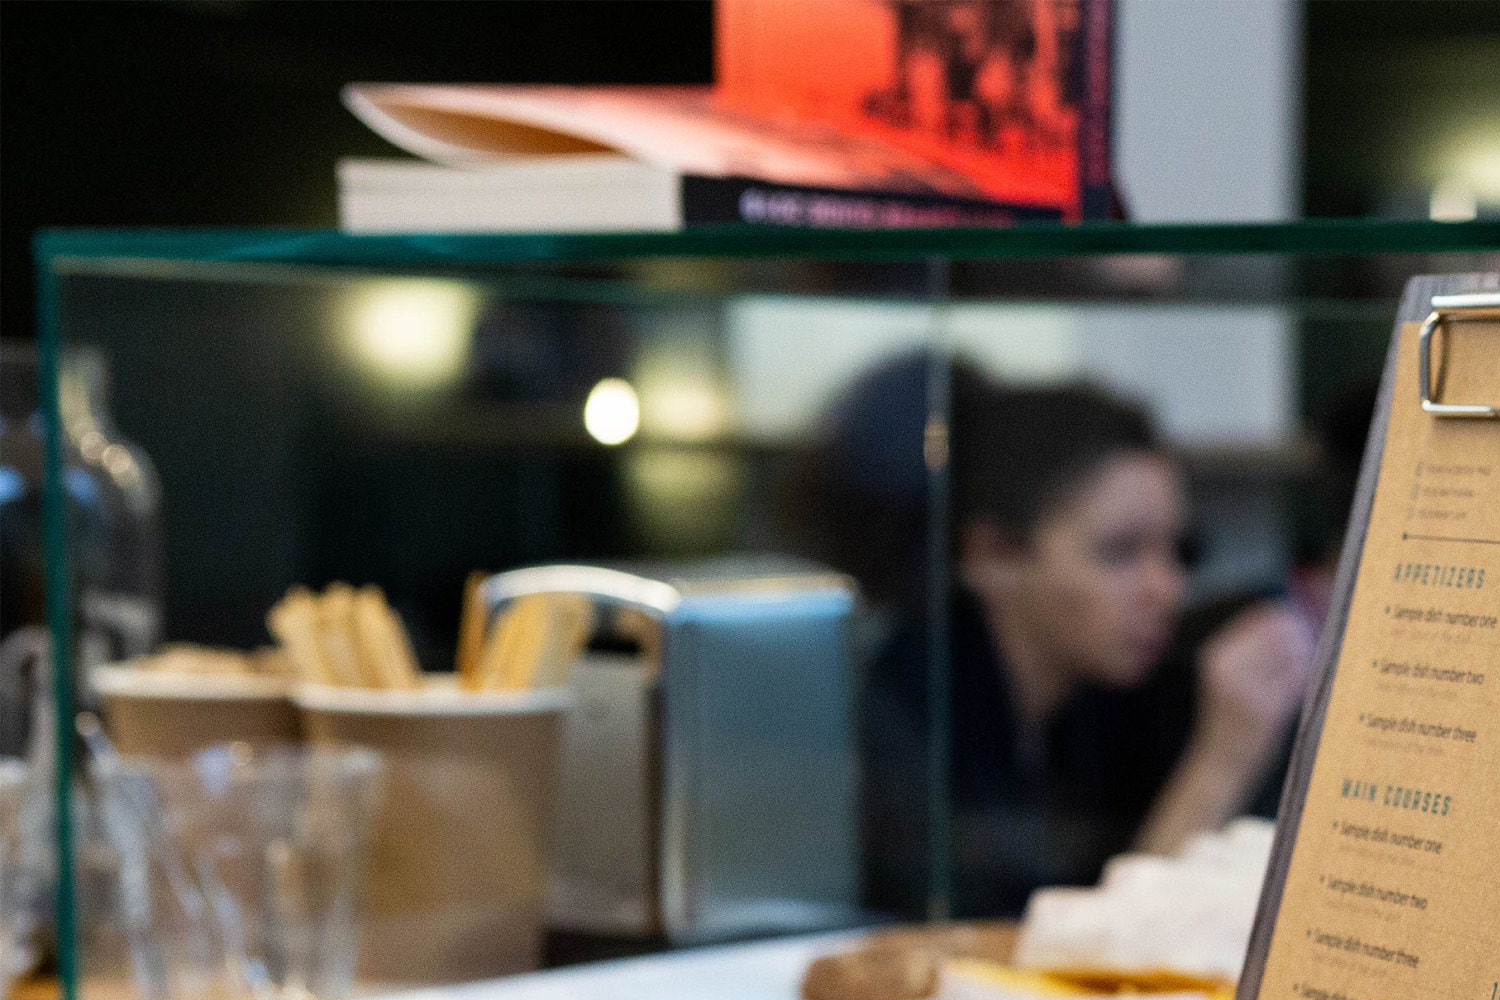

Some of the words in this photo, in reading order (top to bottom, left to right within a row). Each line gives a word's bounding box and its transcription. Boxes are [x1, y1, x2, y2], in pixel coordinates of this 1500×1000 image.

[1394, 563, 1485, 589] APPETIZERS
[1446, 612, 1476, 627] number
[1432, 667, 1465, 683] number
[1419, 723, 1452, 739] number
[1342, 778, 1377, 800] MAIN
[1383, 785, 1451, 817] COURSES
[1391, 833, 1424, 850] number
[1376, 888, 1409, 905] number
[1363, 943, 1396, 961] number
